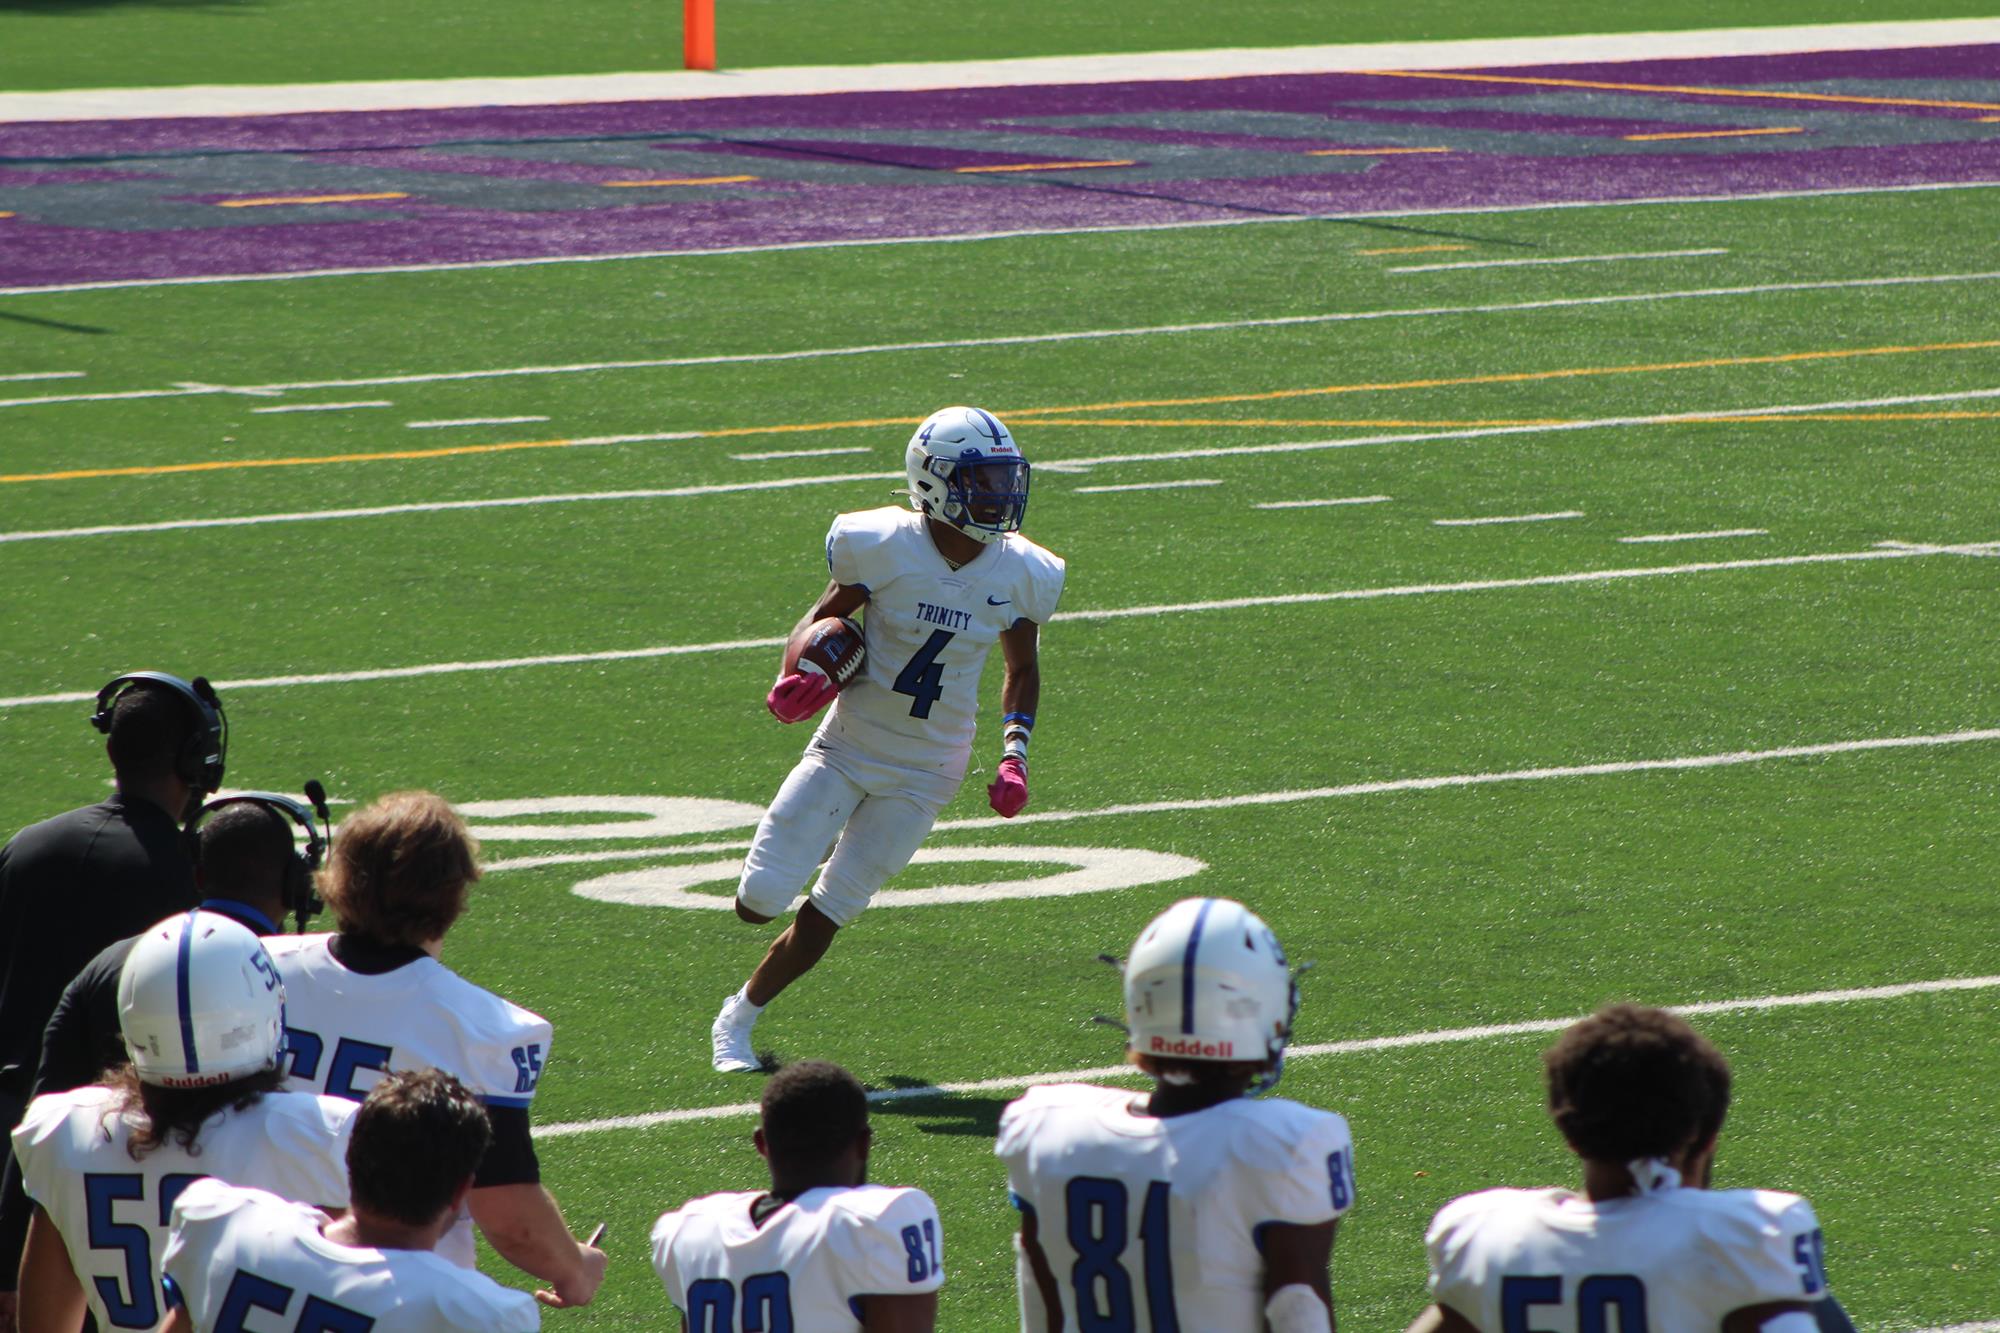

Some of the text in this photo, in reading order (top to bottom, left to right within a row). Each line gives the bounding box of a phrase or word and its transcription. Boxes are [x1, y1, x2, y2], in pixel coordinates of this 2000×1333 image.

[918, 422, 937, 447] 4
[916, 602, 973, 631] TRINITY
[891, 628, 957, 719] 4
[1150, 1036, 1233, 1058] Riddell
[161, 1072, 230, 1089] Riddell
[511, 1044, 542, 1093] 65
[84, 1172, 213, 1330] 5
[1065, 1175, 1182, 1333] 81
